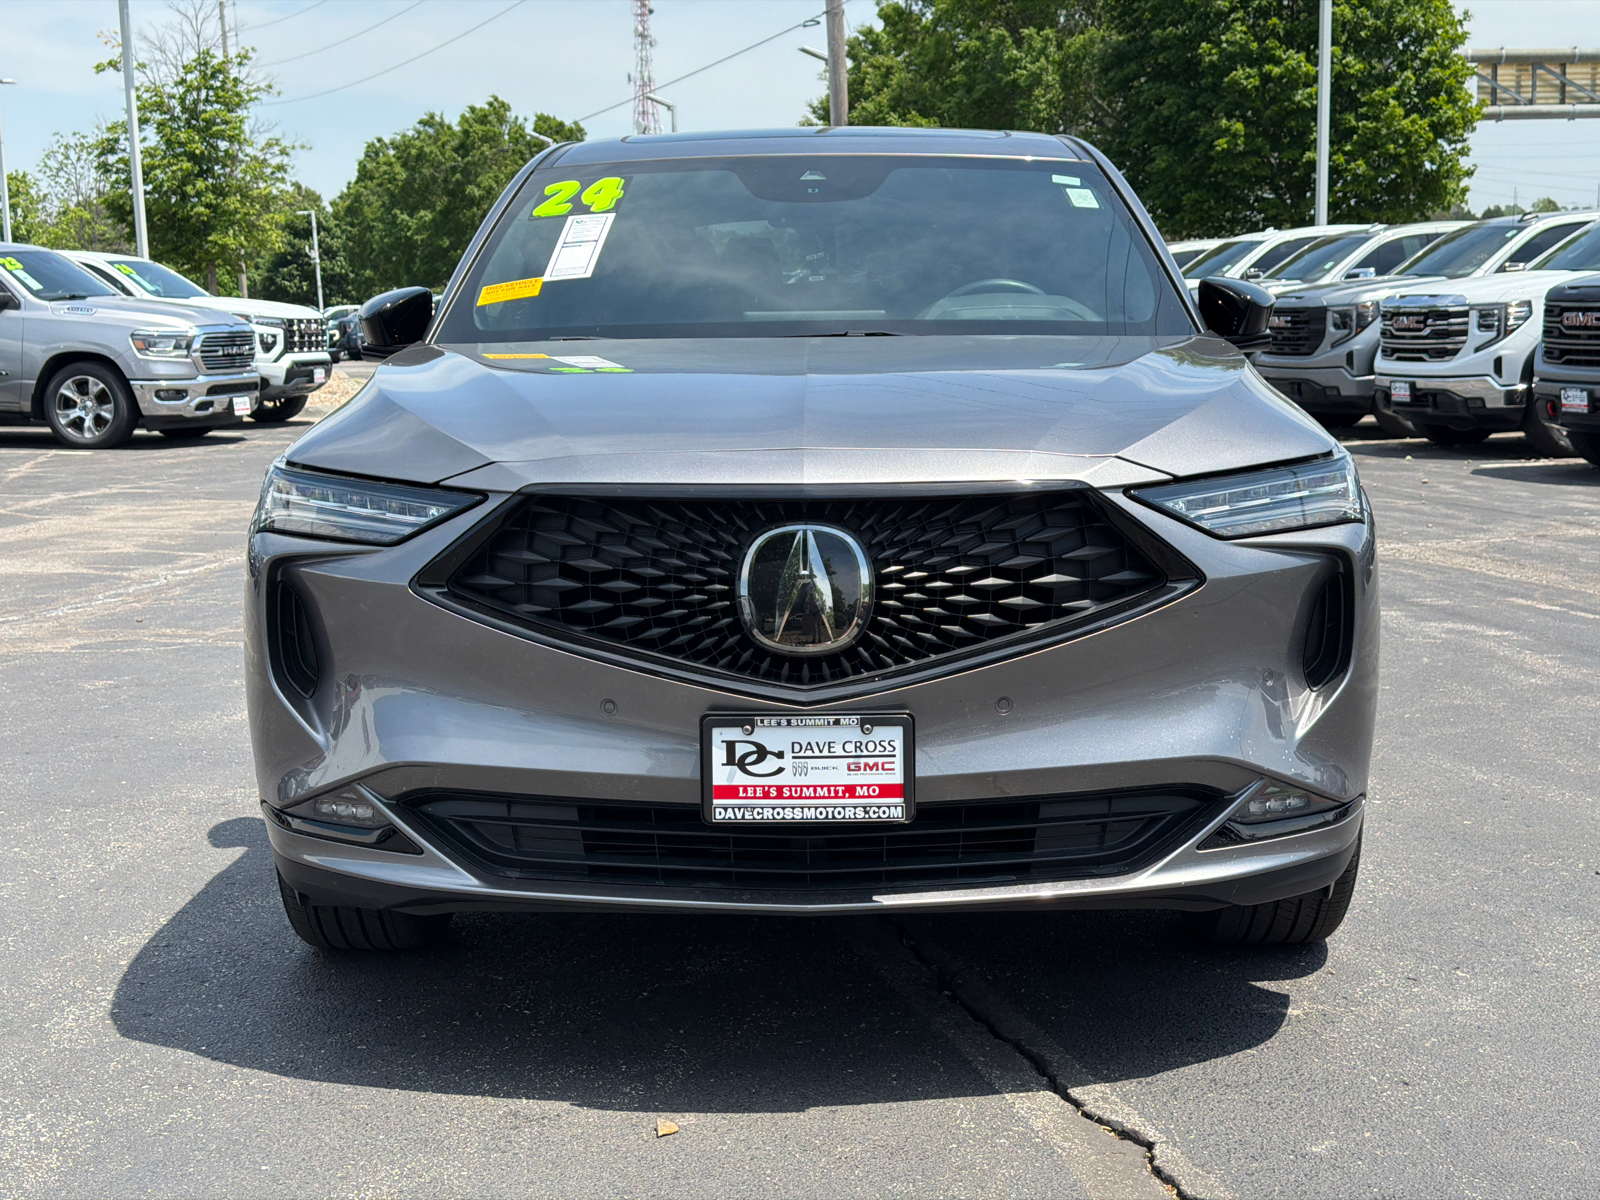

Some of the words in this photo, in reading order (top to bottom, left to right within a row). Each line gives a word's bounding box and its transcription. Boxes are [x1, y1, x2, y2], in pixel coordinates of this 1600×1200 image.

[532, 176, 625, 217] 24
[505, 278, 540, 288] VEHICLE
[1392, 315, 1424, 329] GMC
[222, 345, 248, 355] RAM
[757, 718, 788, 727] LEE'S
[790, 718, 836, 726] SUMMIT
[839, 718, 858, 726] MO
[791, 741, 836, 754] DAVE
[842, 740, 896, 753] CROSS
[846, 761, 895, 772] GMC
[738, 786, 777, 797] LEE'S
[783, 786, 849, 799] SUMMIT,
[855, 786, 879, 796] MO
[715, 806, 902, 820] DAVECROSSMOTORS.COM
